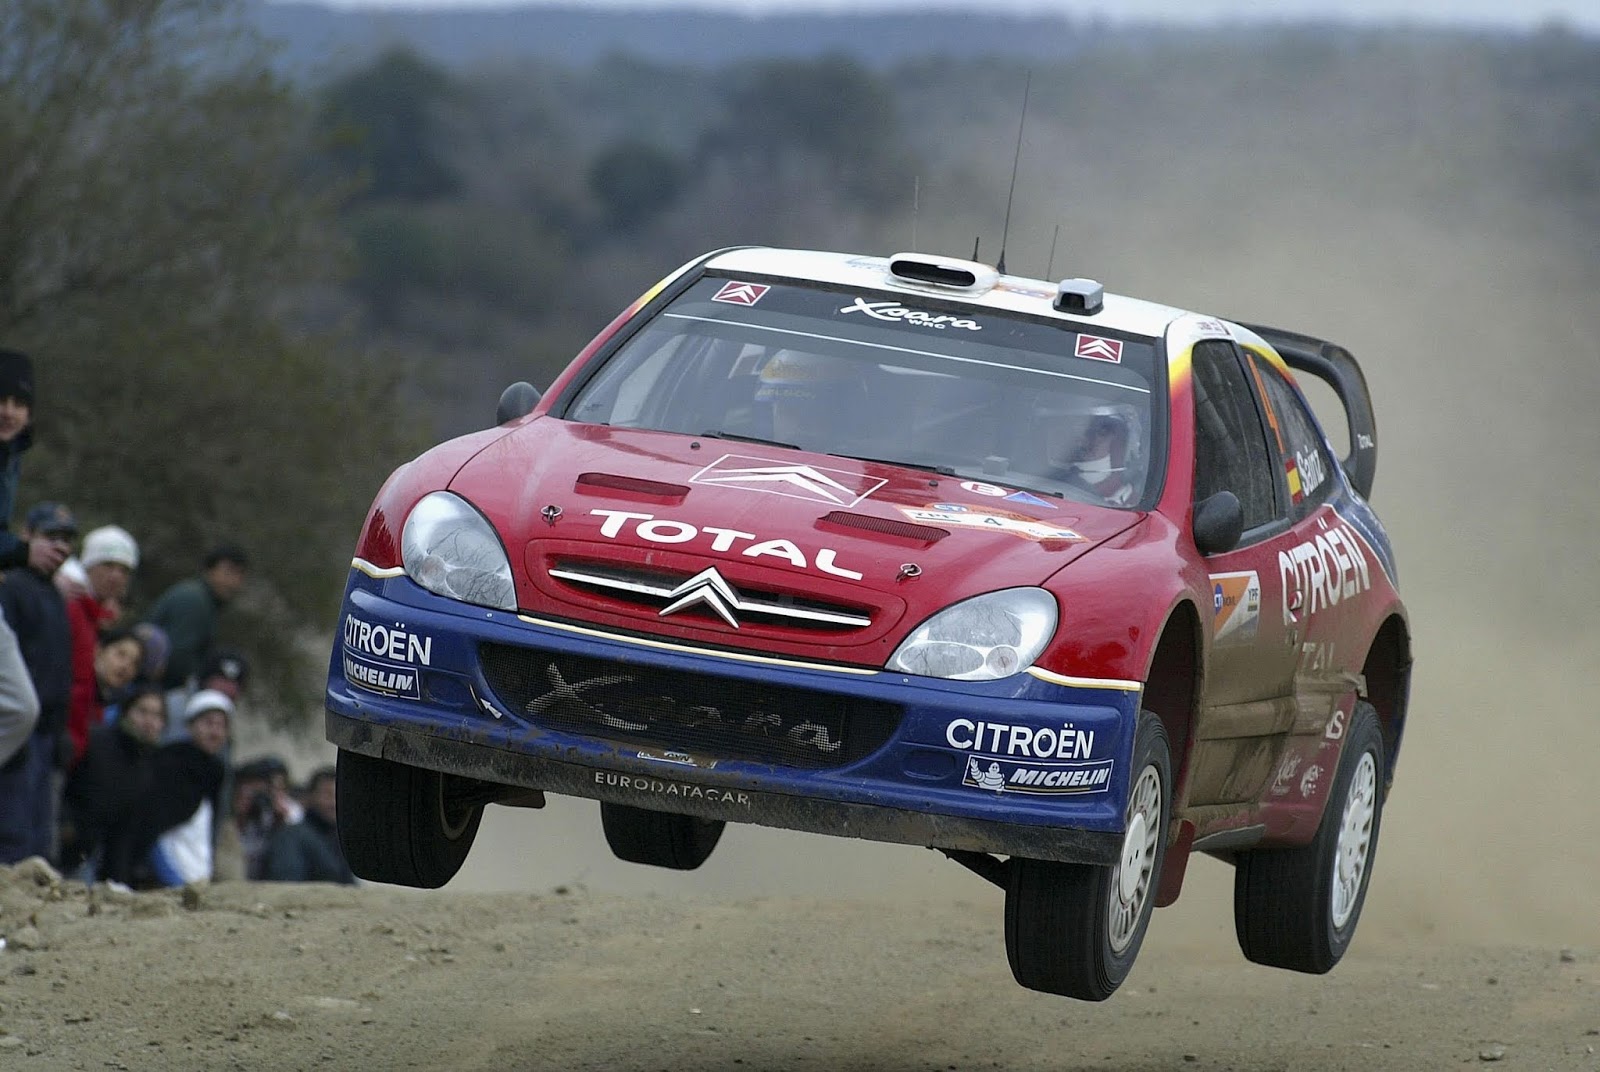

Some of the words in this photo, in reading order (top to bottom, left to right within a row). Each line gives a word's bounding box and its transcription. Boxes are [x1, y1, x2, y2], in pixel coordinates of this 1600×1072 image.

[840, 297, 982, 331] Xsara
[908, 318, 946, 330] WRC
[1296, 444, 1325, 497] Sainz
[590, 509, 863, 581] TOTAL
[1278, 516, 1371, 626] CITROËN
[344, 613, 432, 666] CITROËN
[345, 657, 414, 691] MICHELIN
[946, 718, 1094, 760] CITROËN
[595, 771, 749, 805] EURODATACAR
[1009, 767, 1110, 788] MICHELIN
